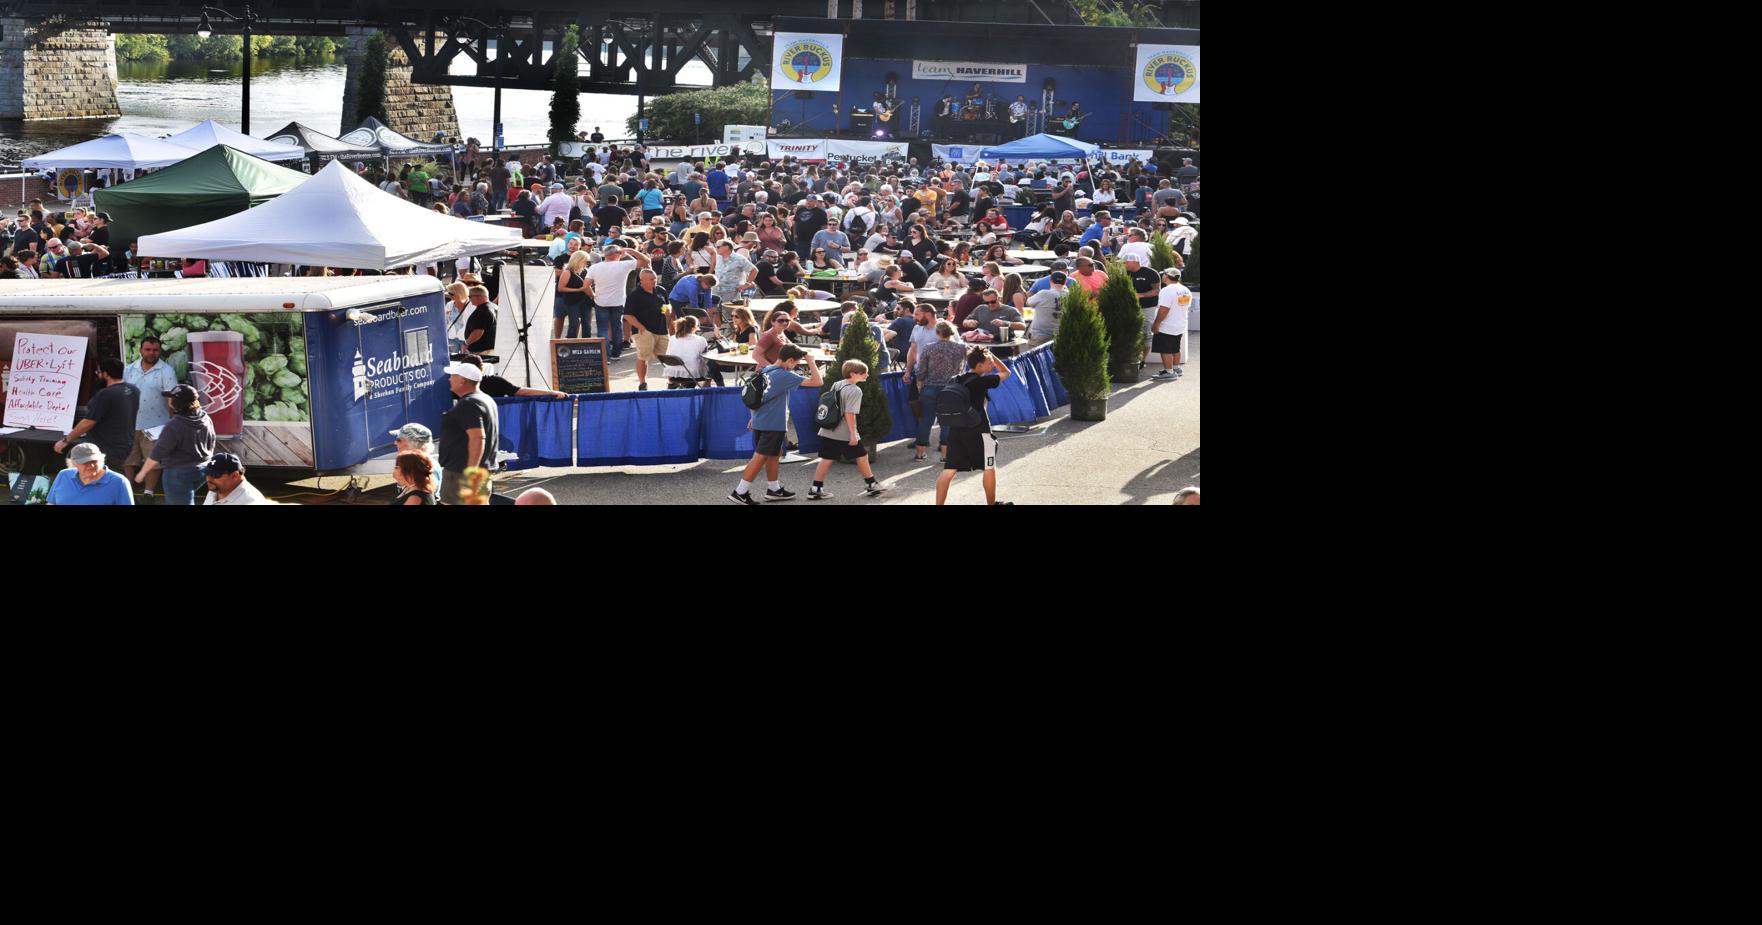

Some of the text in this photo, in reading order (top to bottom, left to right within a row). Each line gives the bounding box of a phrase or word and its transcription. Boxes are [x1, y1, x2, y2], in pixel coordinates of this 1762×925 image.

[782, 44, 830, 67] RIVER RUCKUS
[956, 67, 1023, 76] HAVERHILL
[1145, 56, 1194, 78] RIVER RUCKUS
[655, 147, 682, 157] he
[17, 338, 78, 355] Protect Our
[16, 358, 76, 373] UBER Lyft
[366, 343, 433, 377] Seaboard
[369, 368, 429, 390] PRODUCTS CO.
[39, 388, 64, 398] Care
[374, 388, 395, 398] Sheehan
[413, 379, 435, 389] Company
